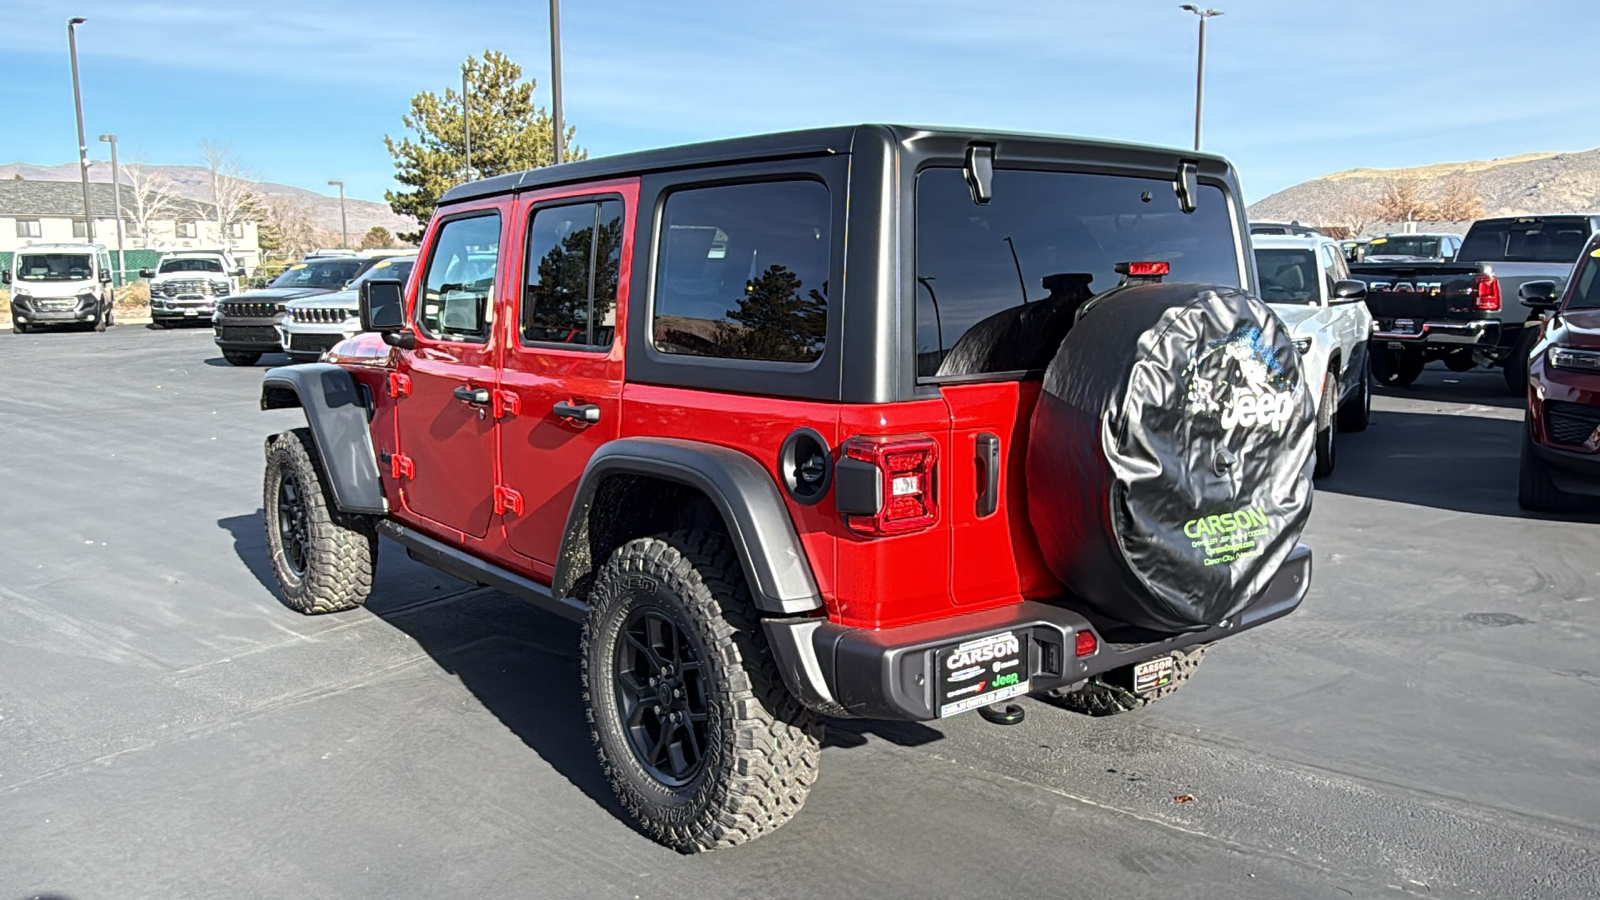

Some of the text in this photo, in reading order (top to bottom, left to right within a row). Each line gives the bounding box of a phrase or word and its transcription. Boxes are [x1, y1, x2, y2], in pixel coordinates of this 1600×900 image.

[1370, 282, 1441, 293] RAM
[1221, 386, 1294, 432] Jeep
[1184, 507, 1268, 538] CARSON
[947, 637, 1019, 669] CARSON
[1137, 660, 1172, 676] CARSON
[992, 673, 1019, 688] Jeep
